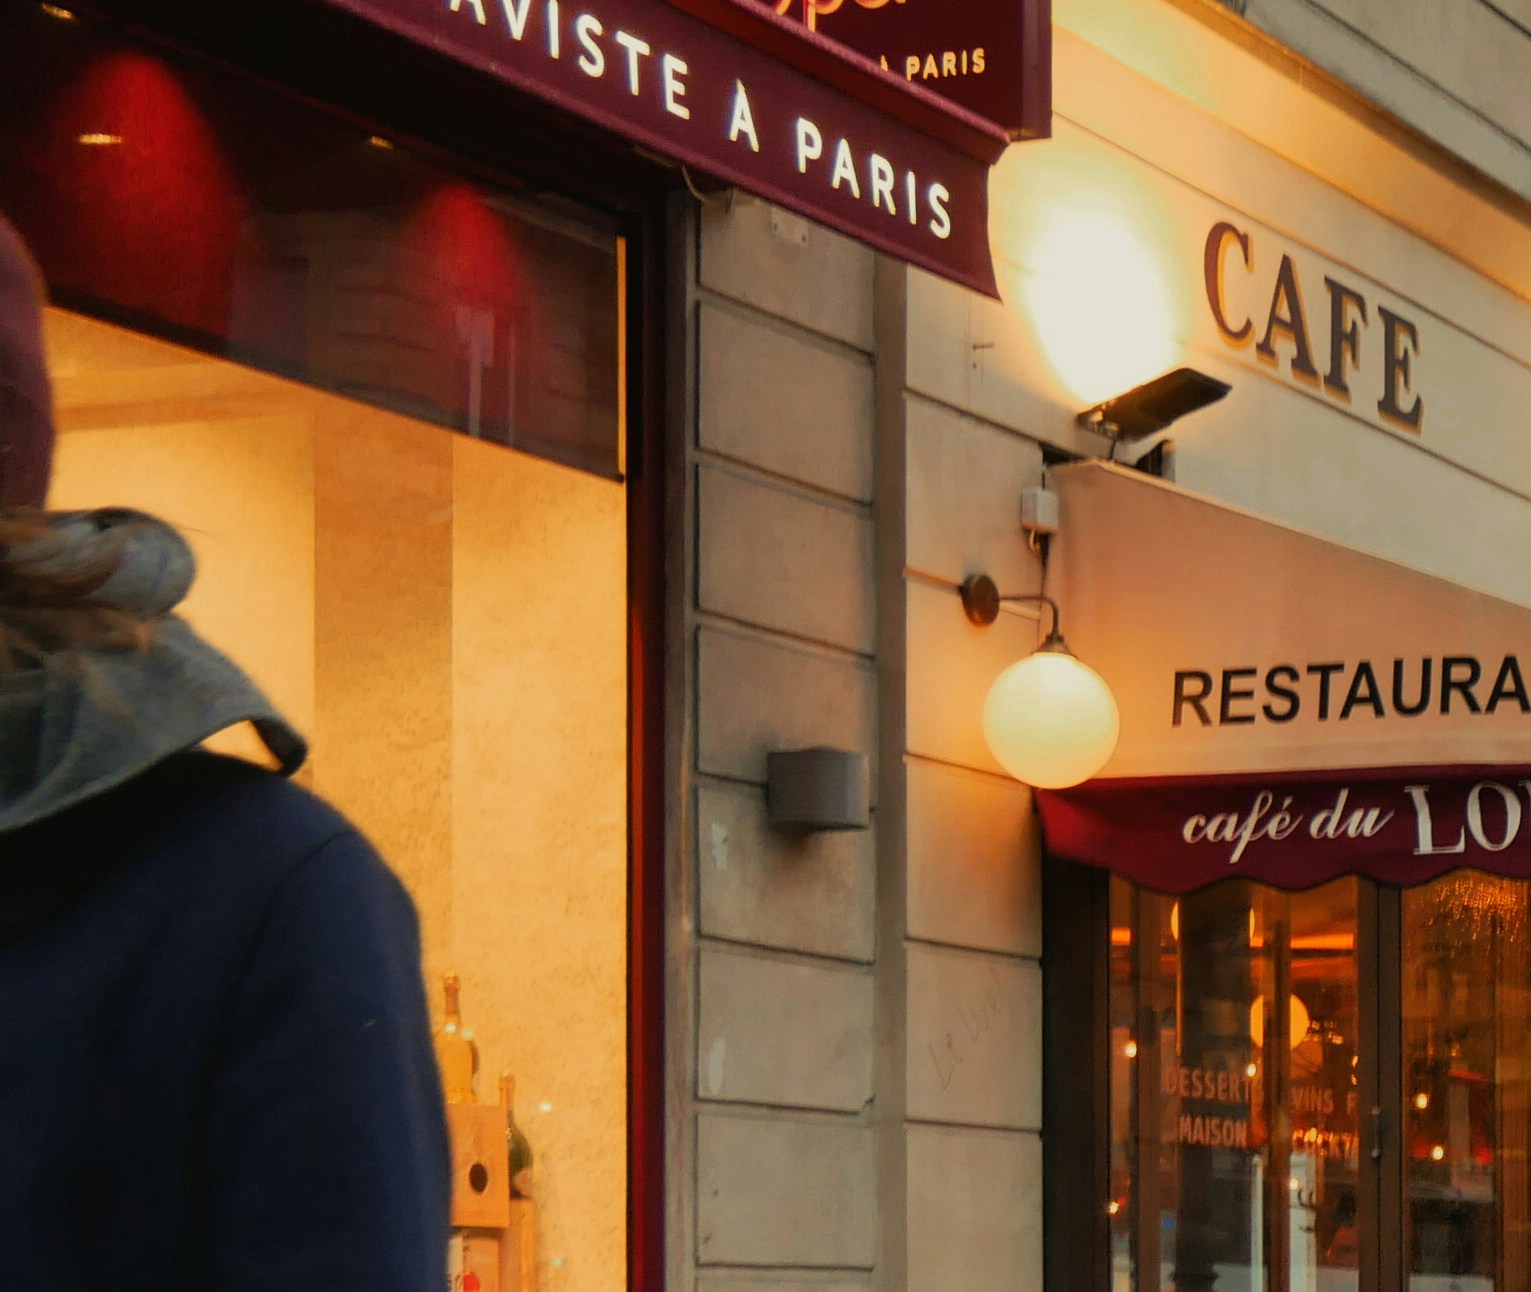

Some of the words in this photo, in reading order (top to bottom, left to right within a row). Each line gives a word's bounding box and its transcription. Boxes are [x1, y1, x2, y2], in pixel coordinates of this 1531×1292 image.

[905, 47, 987, 81] PARIS
[796, 117, 951, 239] PARIS
[1203, 220, 1423, 436] CAFE
[1182, 789, 1304, 864] café
[1309, 786, 1395, 840] du
[1179, 1114, 1249, 1148] MAISON
